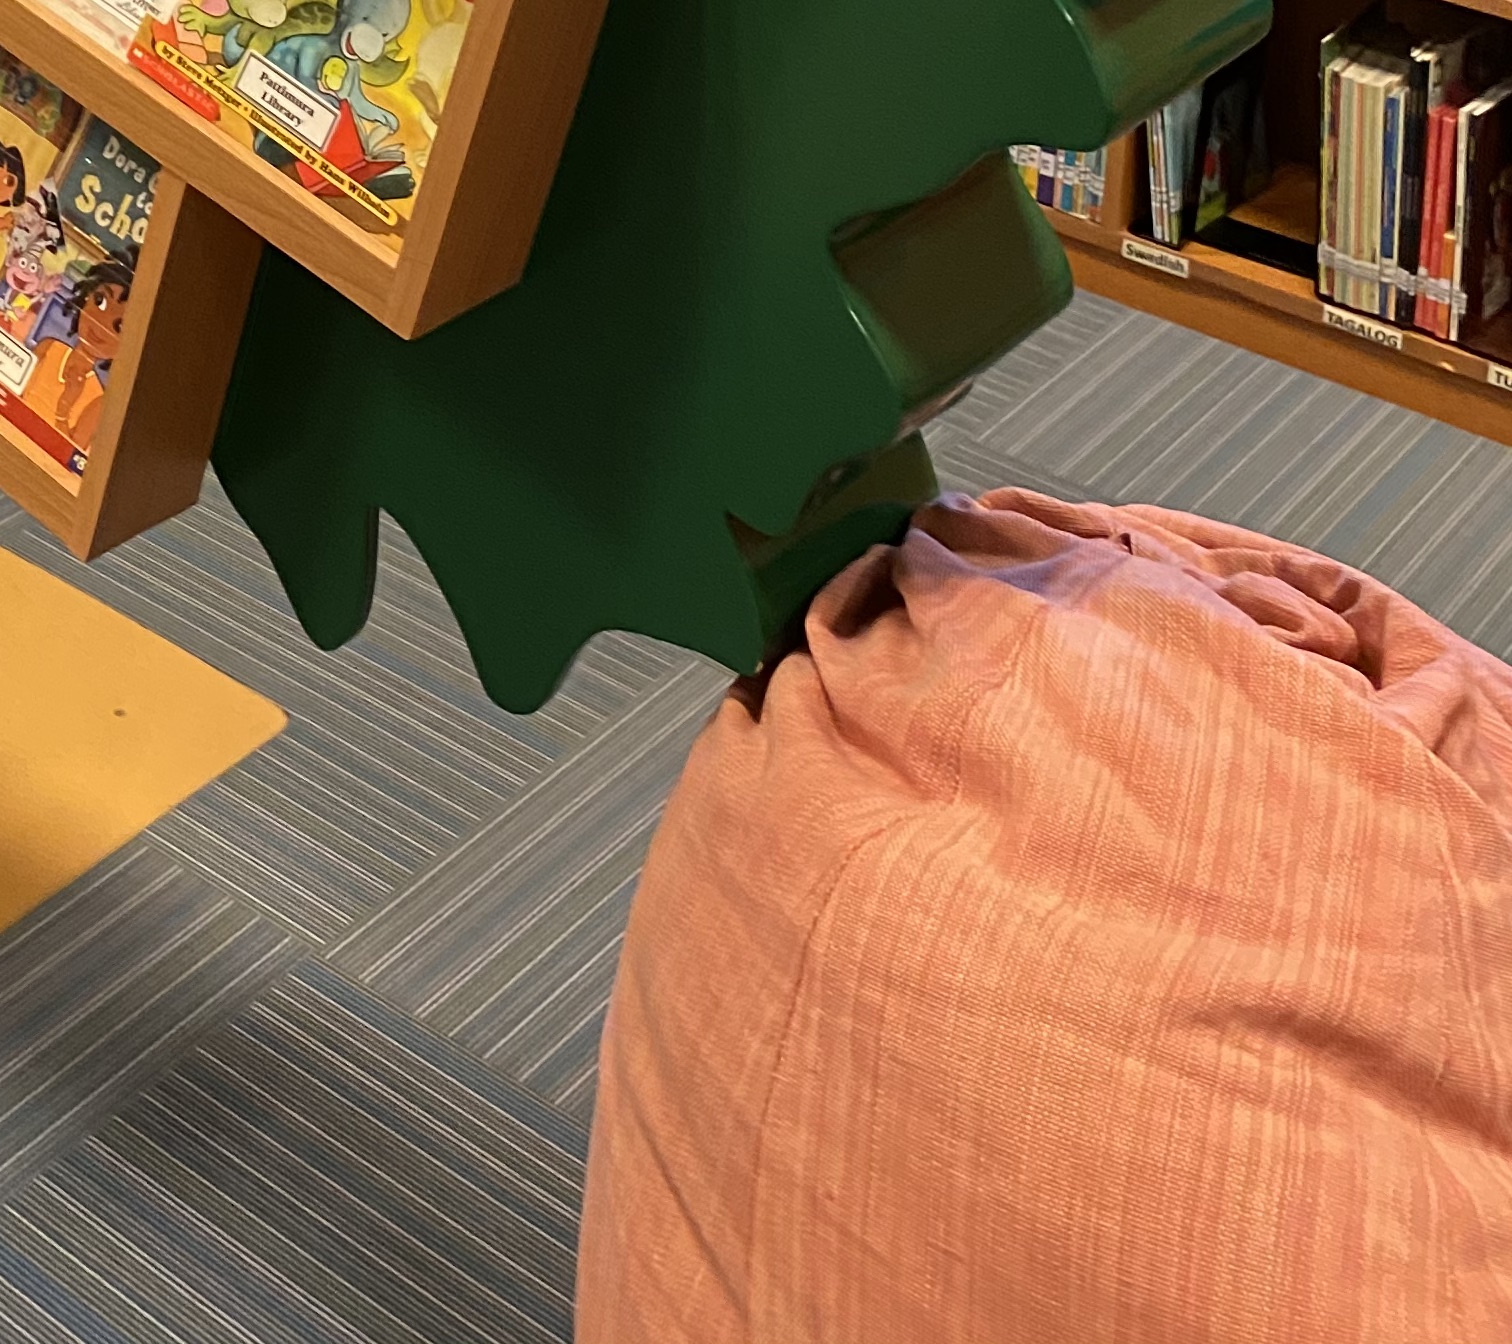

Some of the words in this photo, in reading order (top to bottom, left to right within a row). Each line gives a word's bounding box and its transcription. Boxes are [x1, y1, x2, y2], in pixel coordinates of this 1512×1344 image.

[162, 45, 175, 60] by
[259, 72, 315, 117] Pattimura
[260, 91, 303, 127] Library
[102, 134, 146, 183] Dora
[74, 174, 148, 244] Scho
[1327, 311, 1398, 348] TAGALOG
